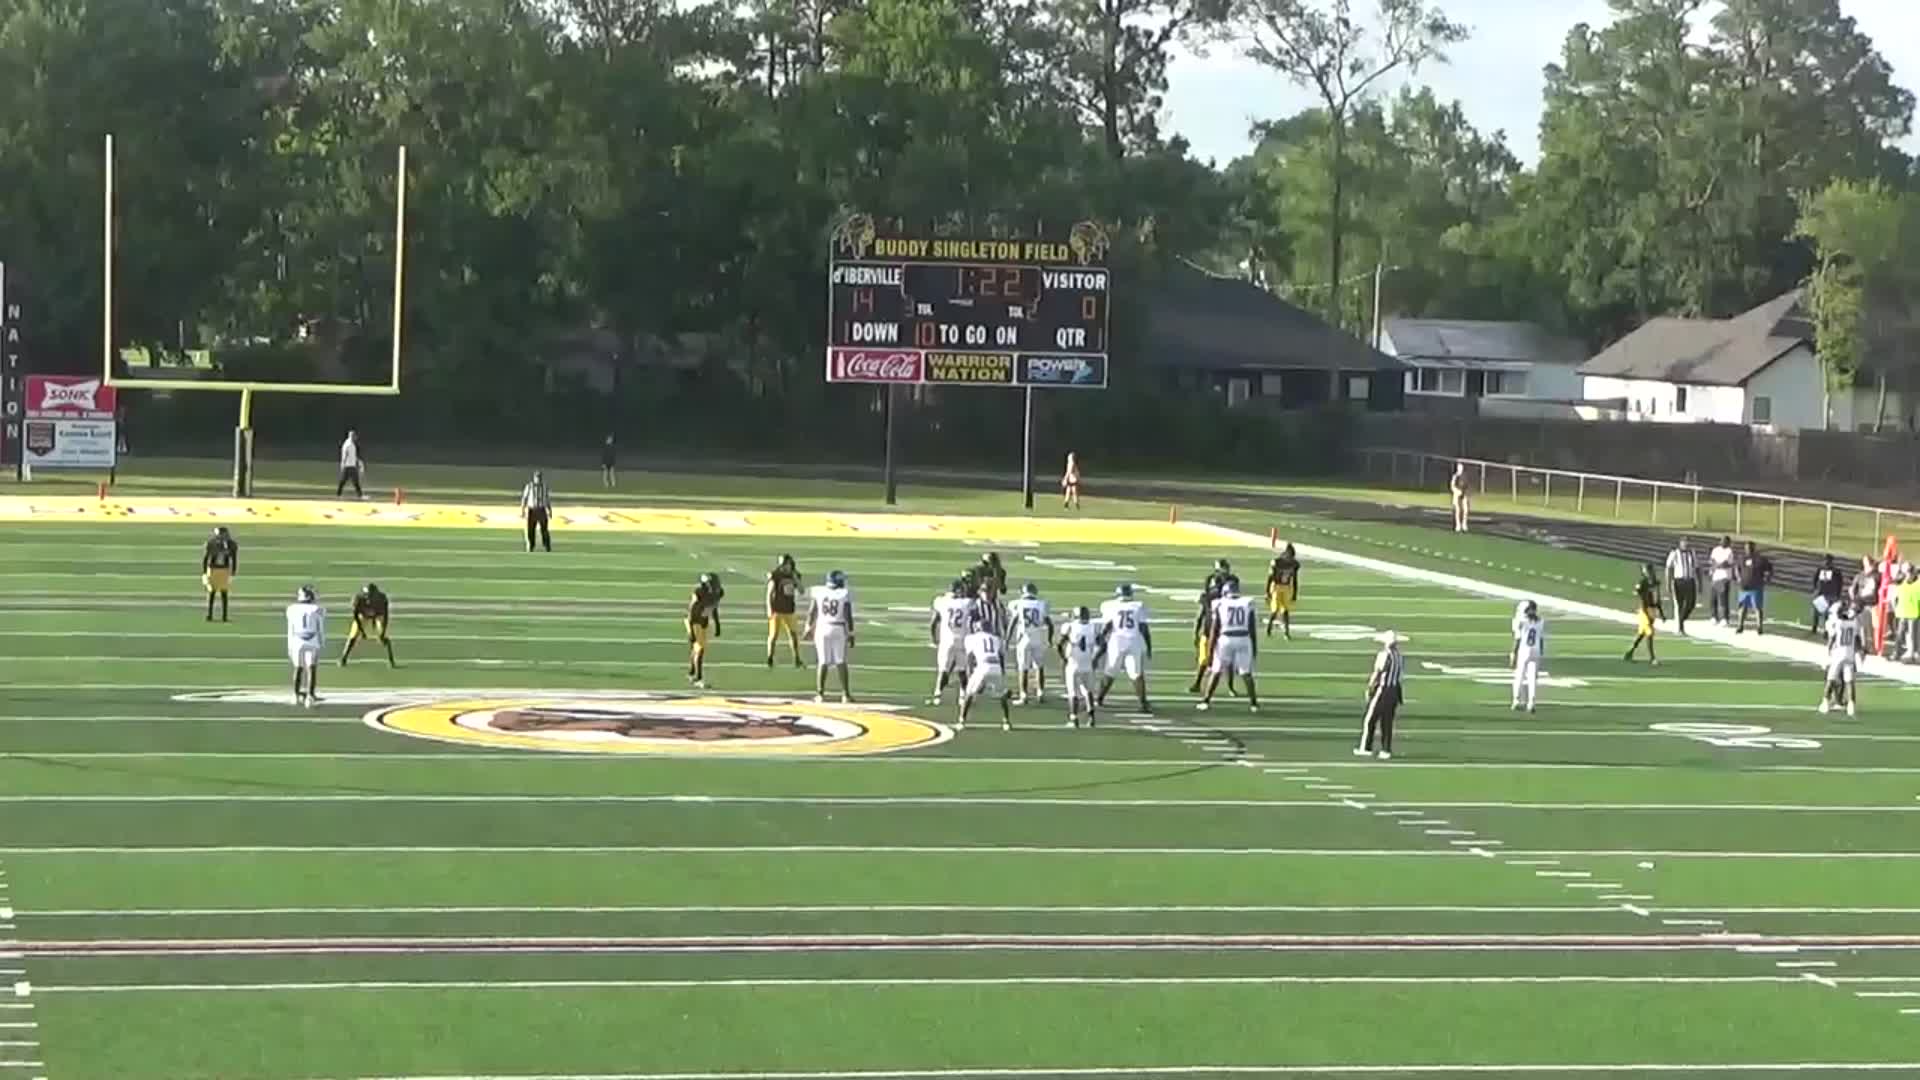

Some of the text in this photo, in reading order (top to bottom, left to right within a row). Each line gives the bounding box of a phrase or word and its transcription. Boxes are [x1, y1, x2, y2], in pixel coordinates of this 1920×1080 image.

[875, 238, 1069, 261] BUDDY SINGLETON FIELD
[957, 268, 1021, 297] 1:22
[1042, 271, 1106, 290] VISITOR
[852, 290, 874, 313] 14
[1082, 296, 1096, 320] 0
[852, 322, 898, 342] DOWN
[915, 323, 936, 346] 10
[939, 324, 1017, 345] TO GO ON
[1057, 328, 1086, 348] QTR
[928, 353, 1011, 368] WARRIOR
[7, 304, 20, 438] NATION
[932, 366, 1006, 381] NATION
[821, 599, 840, 617] 68
[1024, 606, 1039, 624] 50
[1227, 606, 1246, 625] 70
[1118, 610, 1135, 628] 75
[1526, 628, 1537, 647] 8
